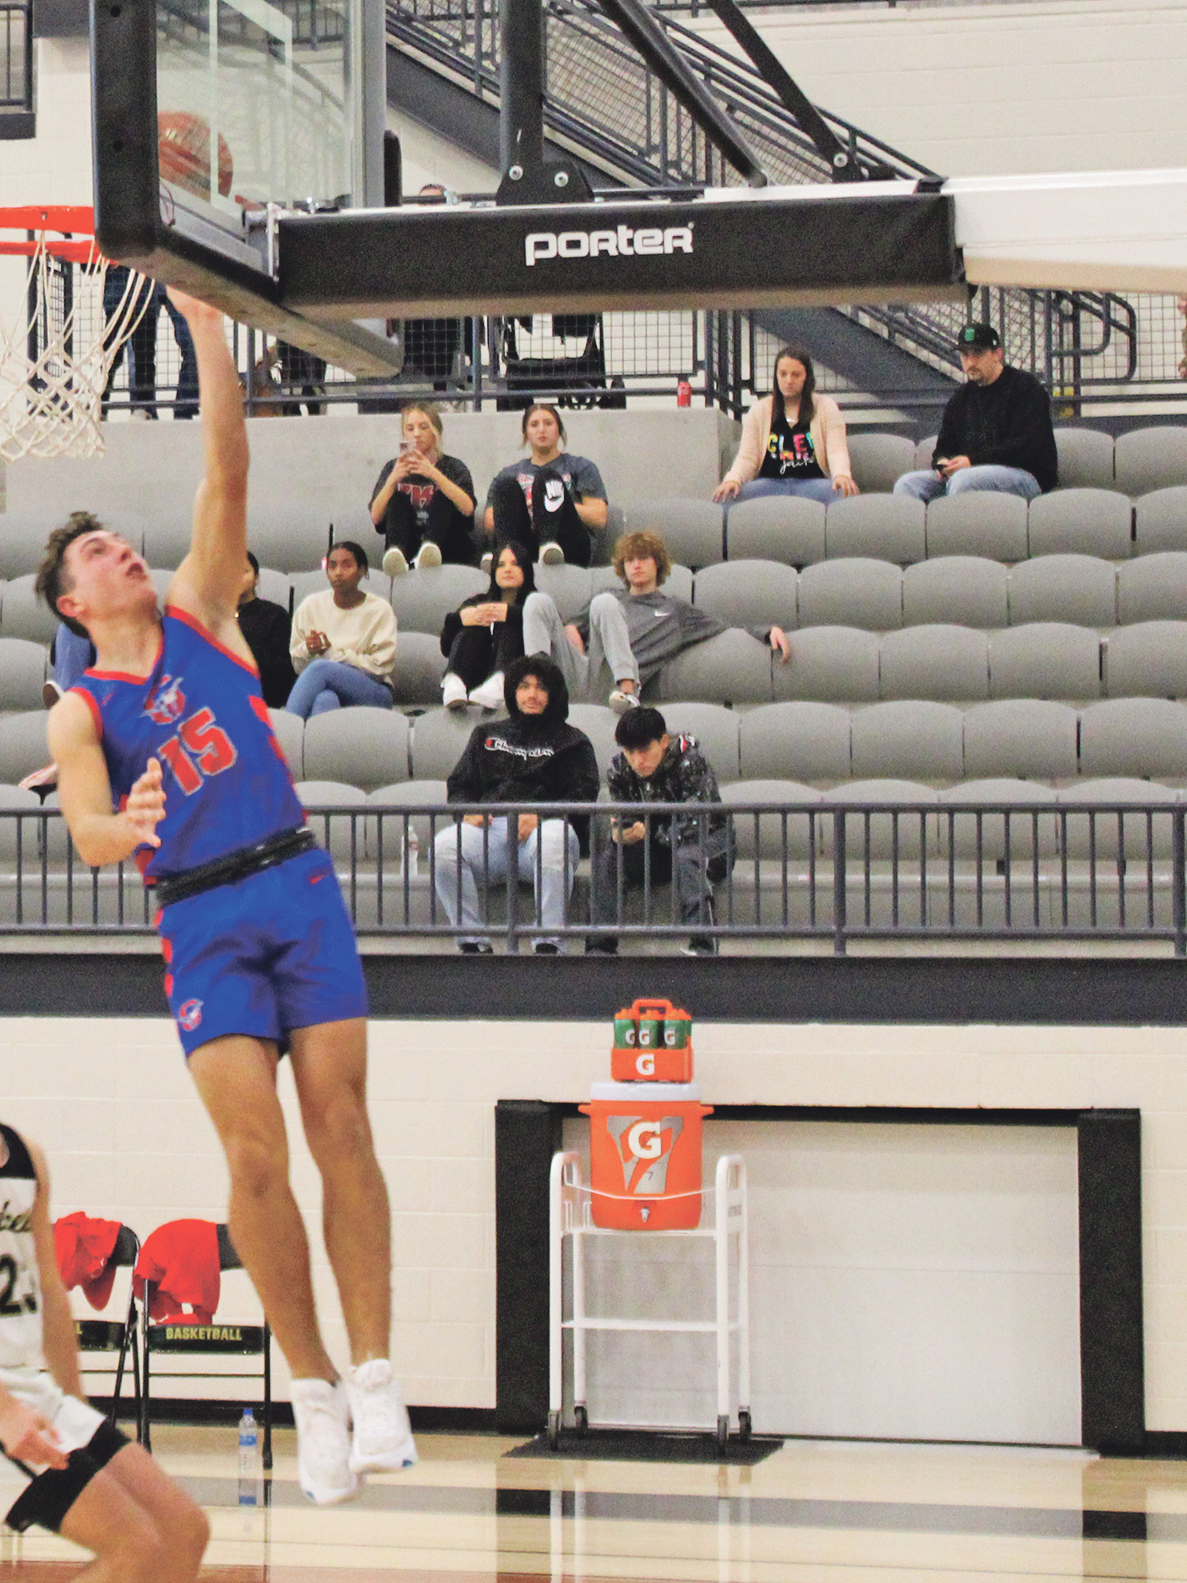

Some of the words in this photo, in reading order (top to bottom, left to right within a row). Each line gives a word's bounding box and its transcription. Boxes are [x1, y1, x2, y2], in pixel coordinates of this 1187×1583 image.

[157, 706, 239, 797] 15
[639, 1029, 650, 1046] G
[664, 1029, 676, 1046] G
[635, 1053, 655, 1076] G
[628, 1121, 662, 1160] G
[165, 1327, 243, 1341] BASKETBALL
